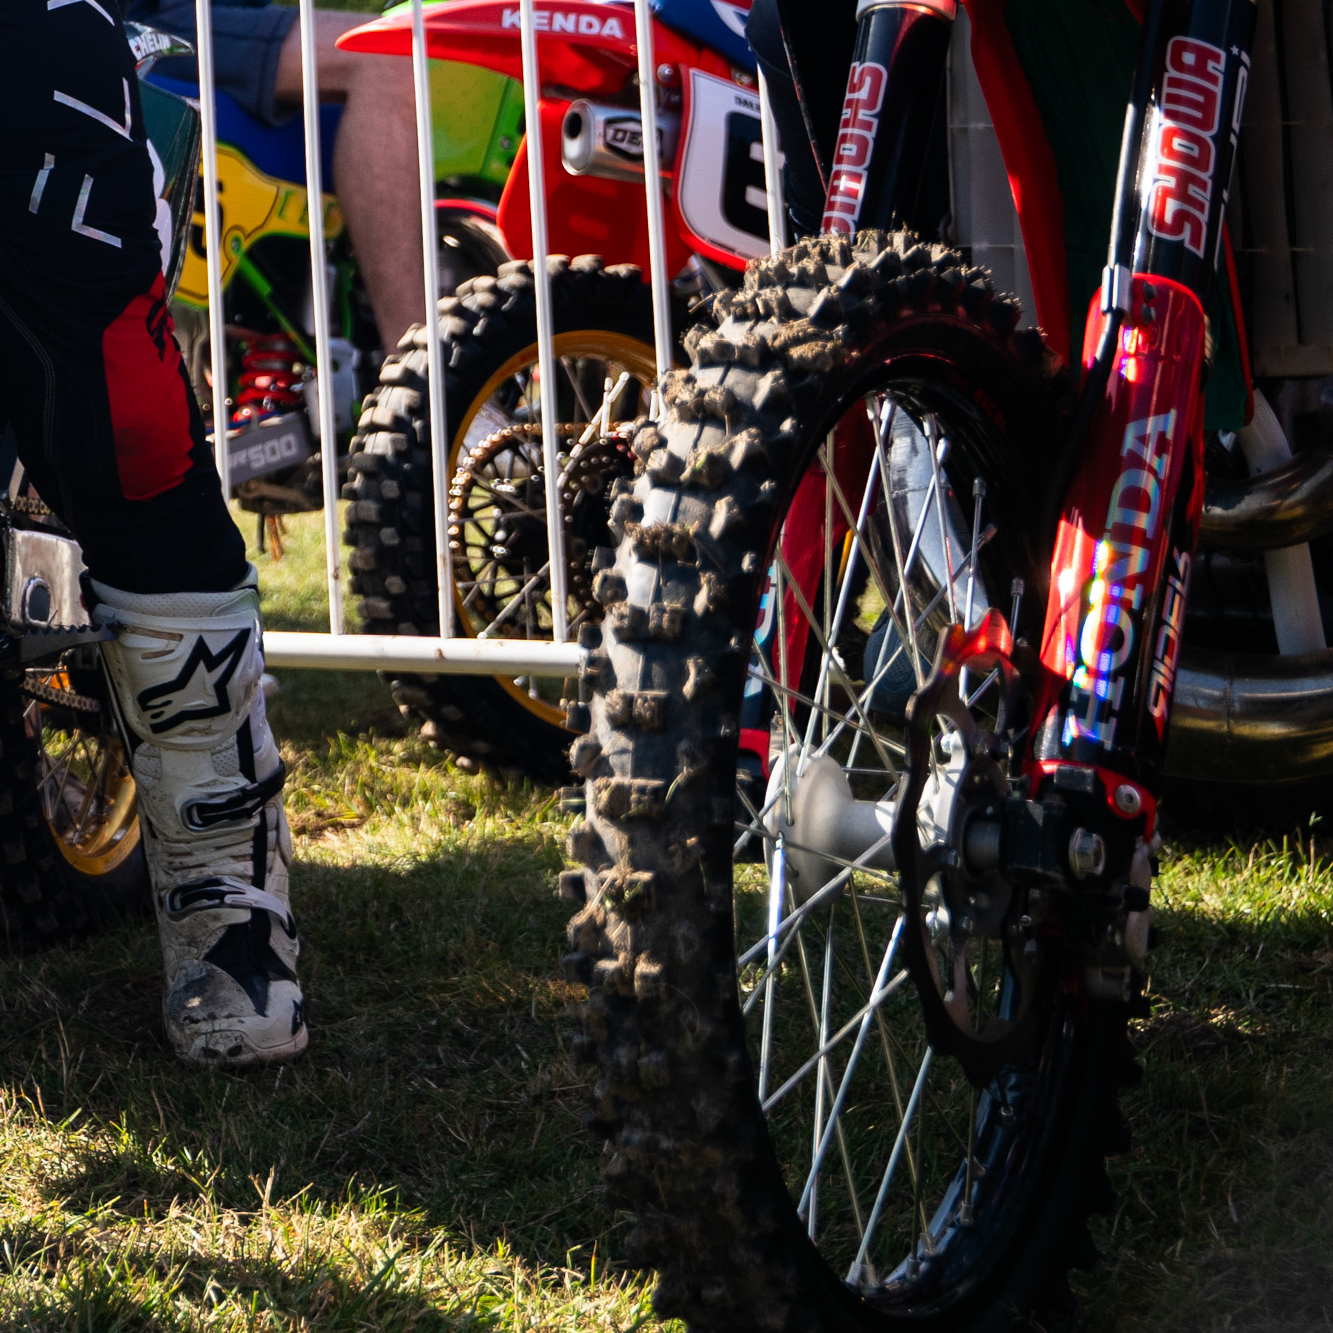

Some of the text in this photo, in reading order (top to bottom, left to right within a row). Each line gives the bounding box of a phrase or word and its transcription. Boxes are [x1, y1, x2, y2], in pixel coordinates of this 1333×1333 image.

[501, 8, 624, 40] KENDA
[610, 127, 643, 145] DE
[1151, 35, 1226, 259] SHOWA
[1062, 408, 1178, 752] HONDA
